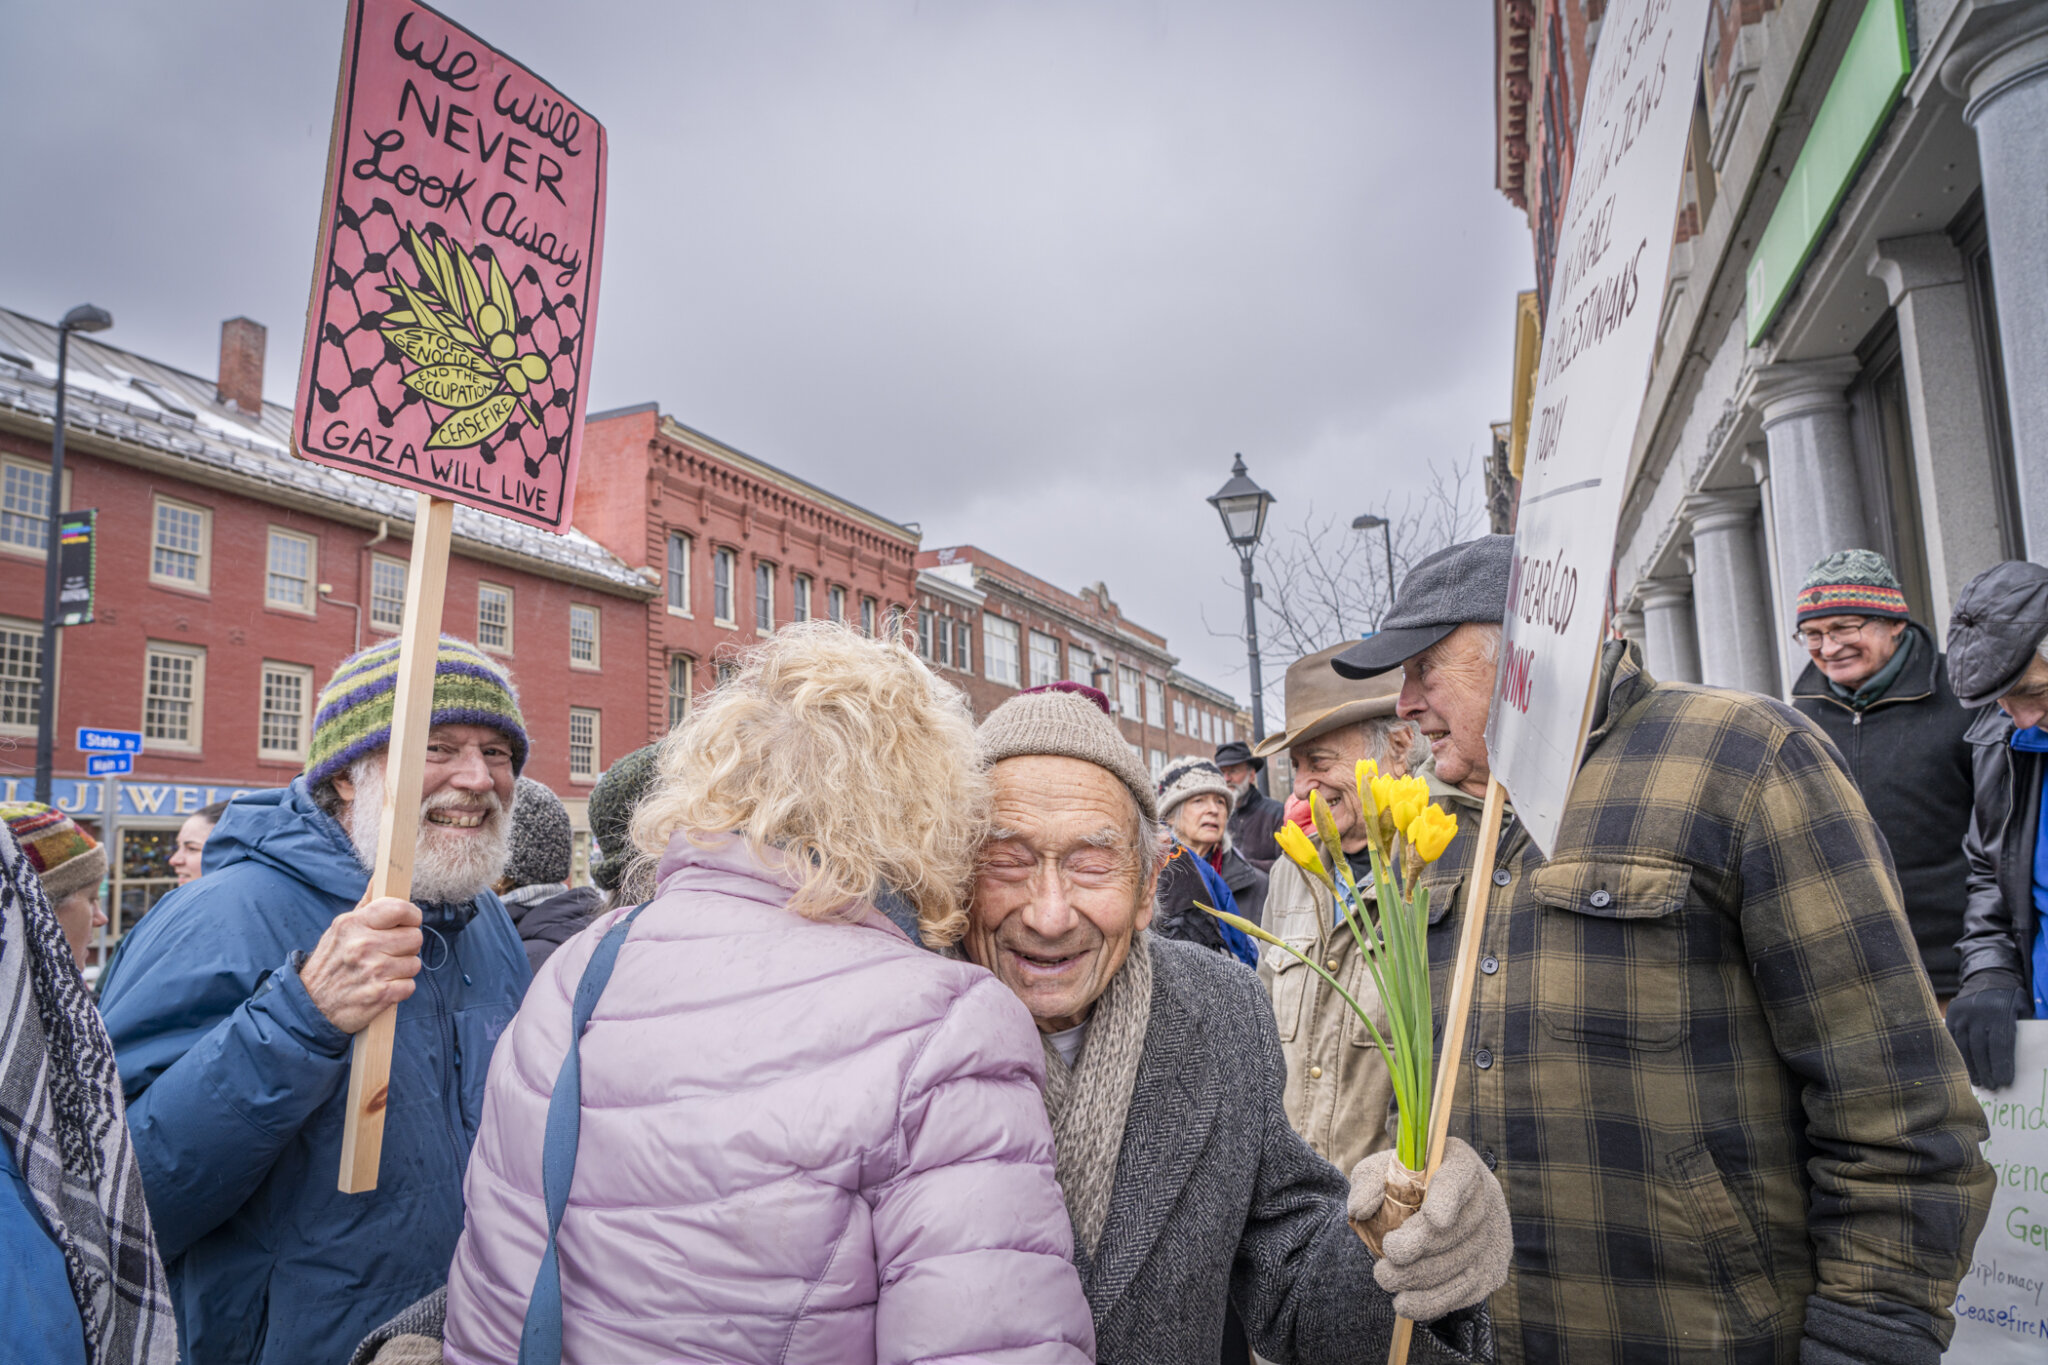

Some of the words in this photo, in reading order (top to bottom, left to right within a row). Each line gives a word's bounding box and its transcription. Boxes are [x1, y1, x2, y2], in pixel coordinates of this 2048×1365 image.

[394, 12, 480, 92] We
[493, 74, 581, 157] Will
[1614, 28, 1673, 167] JEWS
[398, 79, 567, 207] NEVER
[352, 129, 477, 226] Look
[481, 192, 582, 287] Away
[1569, 193, 1617, 296] ISRAEL
[393, 333, 481, 370] GENOCIDE
[404, 329, 467, 353] STOP
[414, 380, 493, 404] OCCUPATION
[418, 367, 450, 381] END
[451, 368, 480, 384] THE
[438, 397, 512, 445] CEASEFIRE
[322, 420, 419, 474] GAZA
[430, 453, 490, 493] WILL
[501, 475, 549, 511] LIVE
[1519, 558, 1551, 626] HEAR
[1547, 547, 1578, 636] GOD
[86, 732, 120, 749] State
[1973, 1068, 2048, 1130] riend
[1955, 1294, 2036, 1336] Ceasefire
